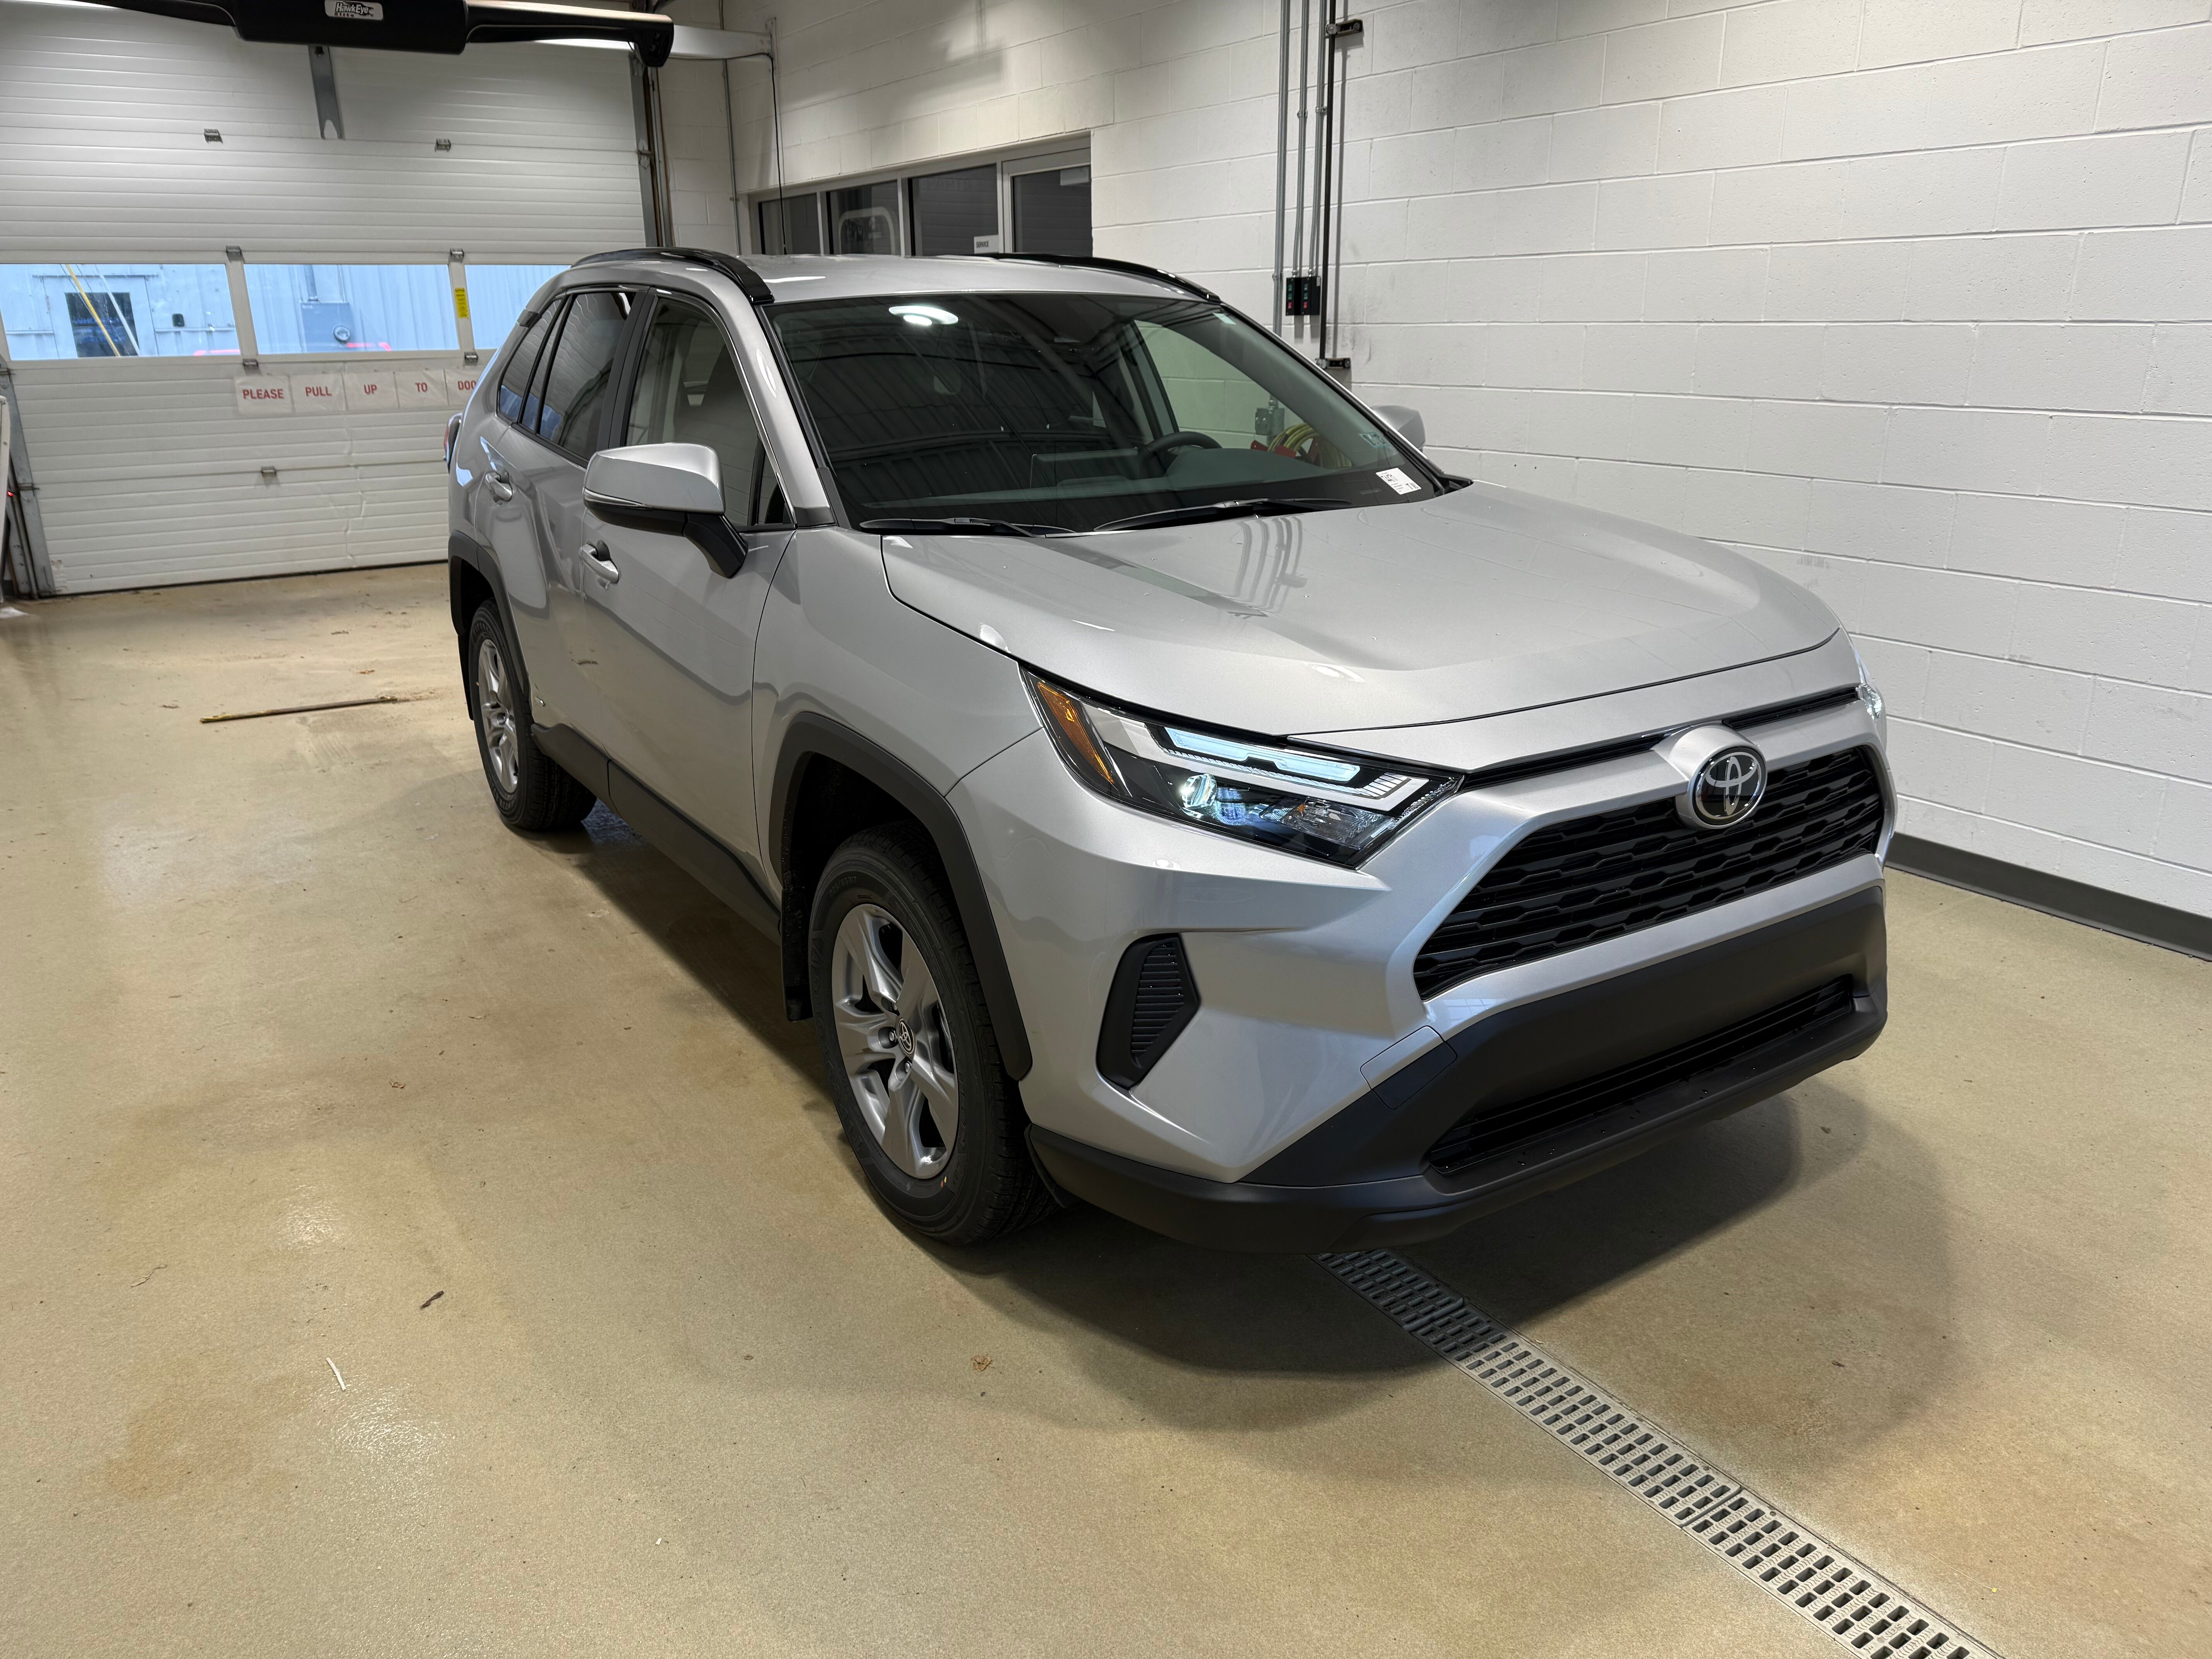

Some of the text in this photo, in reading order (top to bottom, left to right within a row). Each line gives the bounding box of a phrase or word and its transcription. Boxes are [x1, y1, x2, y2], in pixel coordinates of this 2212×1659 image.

[336, 2, 368, 14] HawkEye
[242, 380, 477, 400] PLEASE PULL UP TO DOO
[828, 876, 857, 898] 225/65R17
